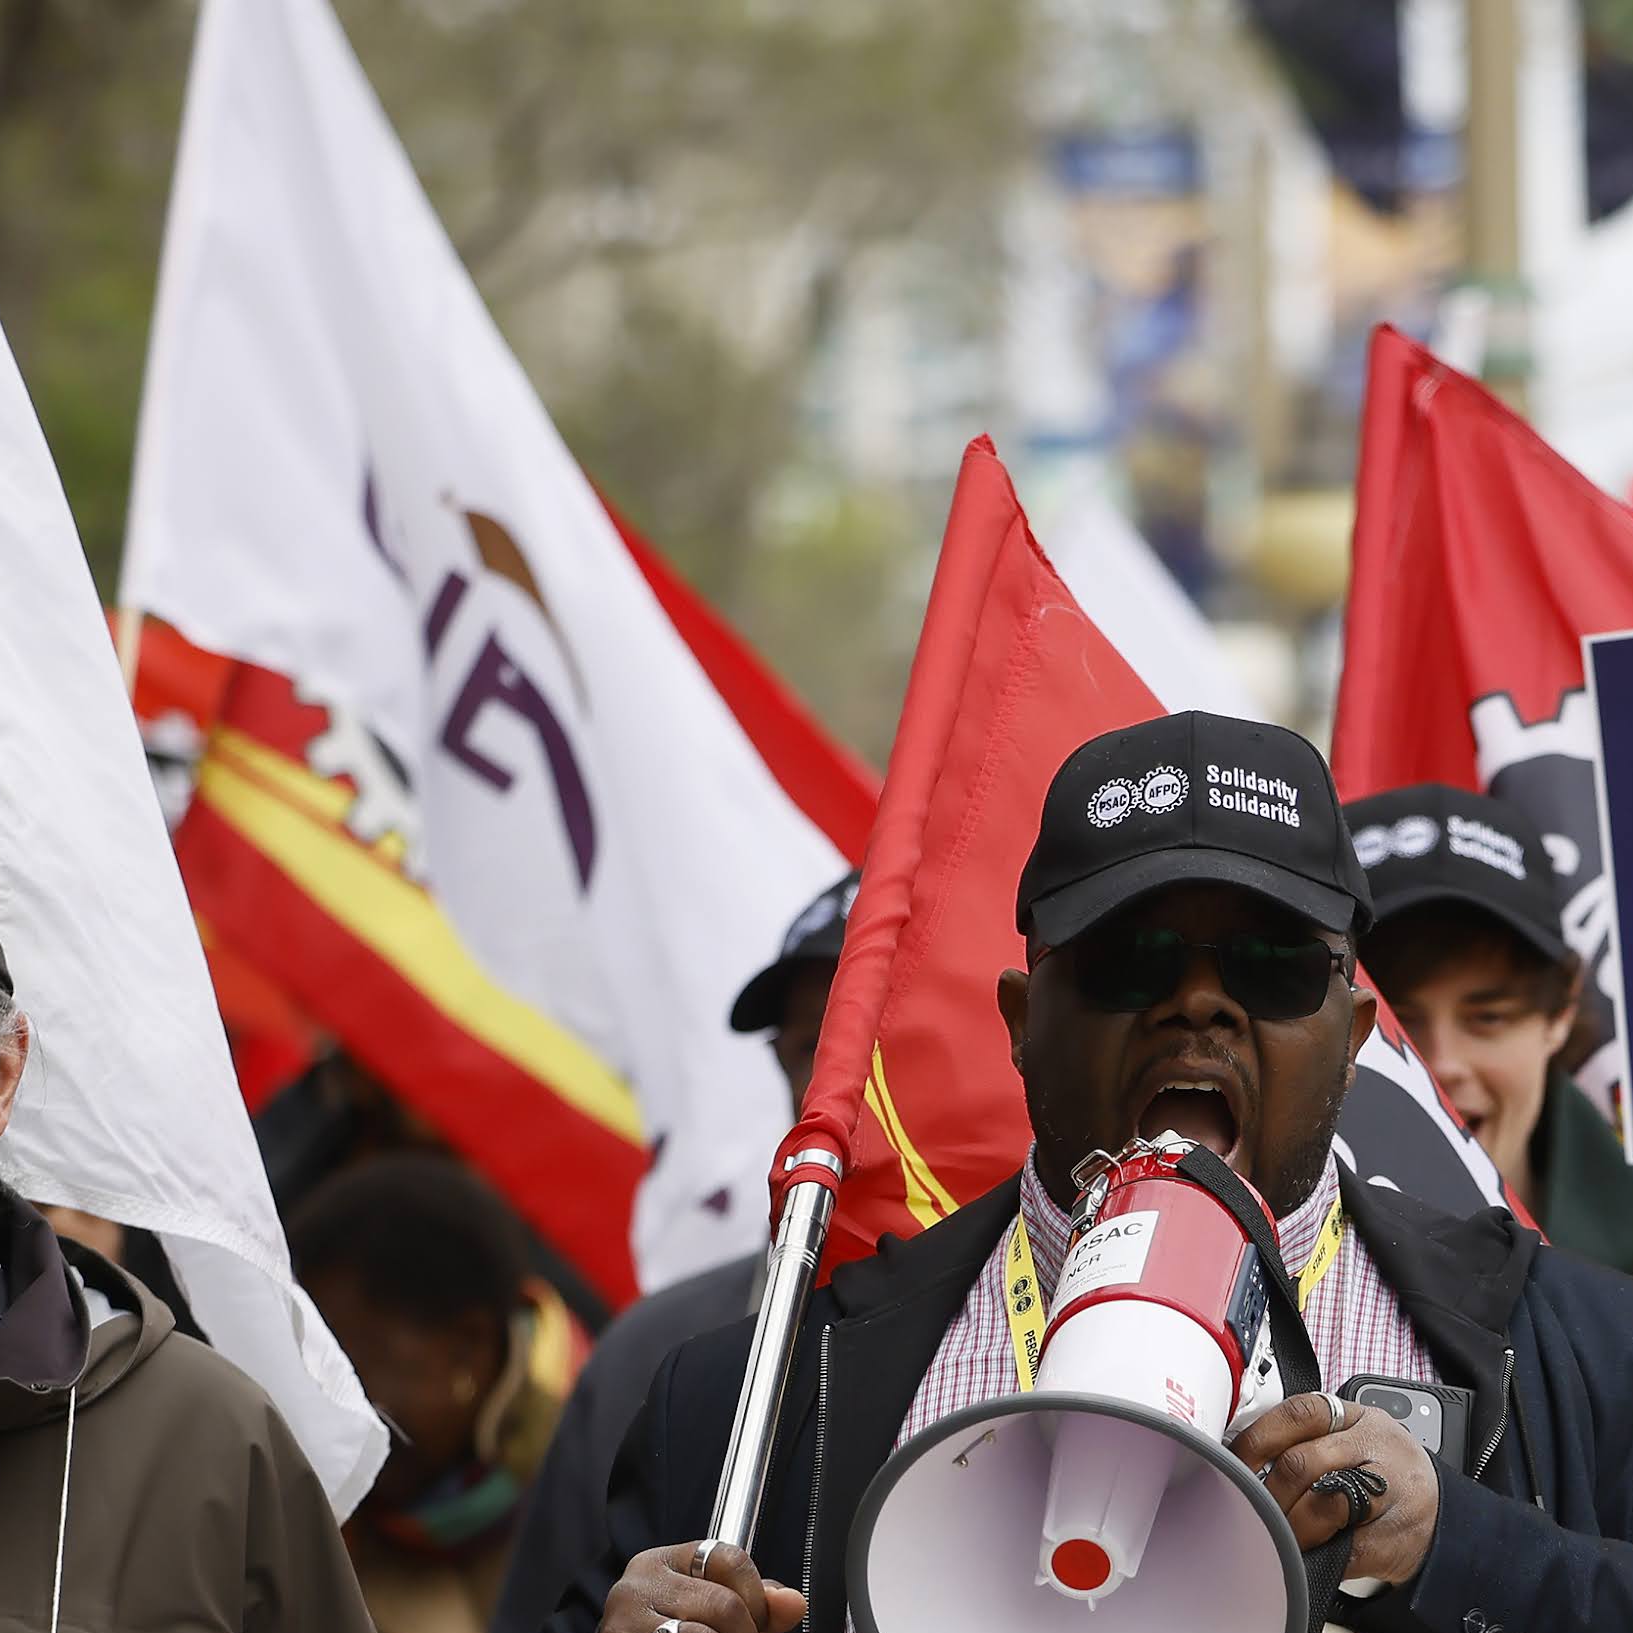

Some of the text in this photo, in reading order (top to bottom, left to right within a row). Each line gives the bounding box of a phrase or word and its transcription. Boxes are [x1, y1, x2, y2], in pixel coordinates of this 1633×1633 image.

[1099, 782, 1180, 813] PSAC AFPC
[1206, 764, 1298, 807] Solidarity
[1208, 787, 1301, 828] Solidarité
[1074, 1222, 1143, 1261] PSAC
[1312, 1243, 1326, 1274] STAFF
[1066, 1253, 1101, 1283] NCR
[1024, 1329, 1039, 1386] PERSONN
